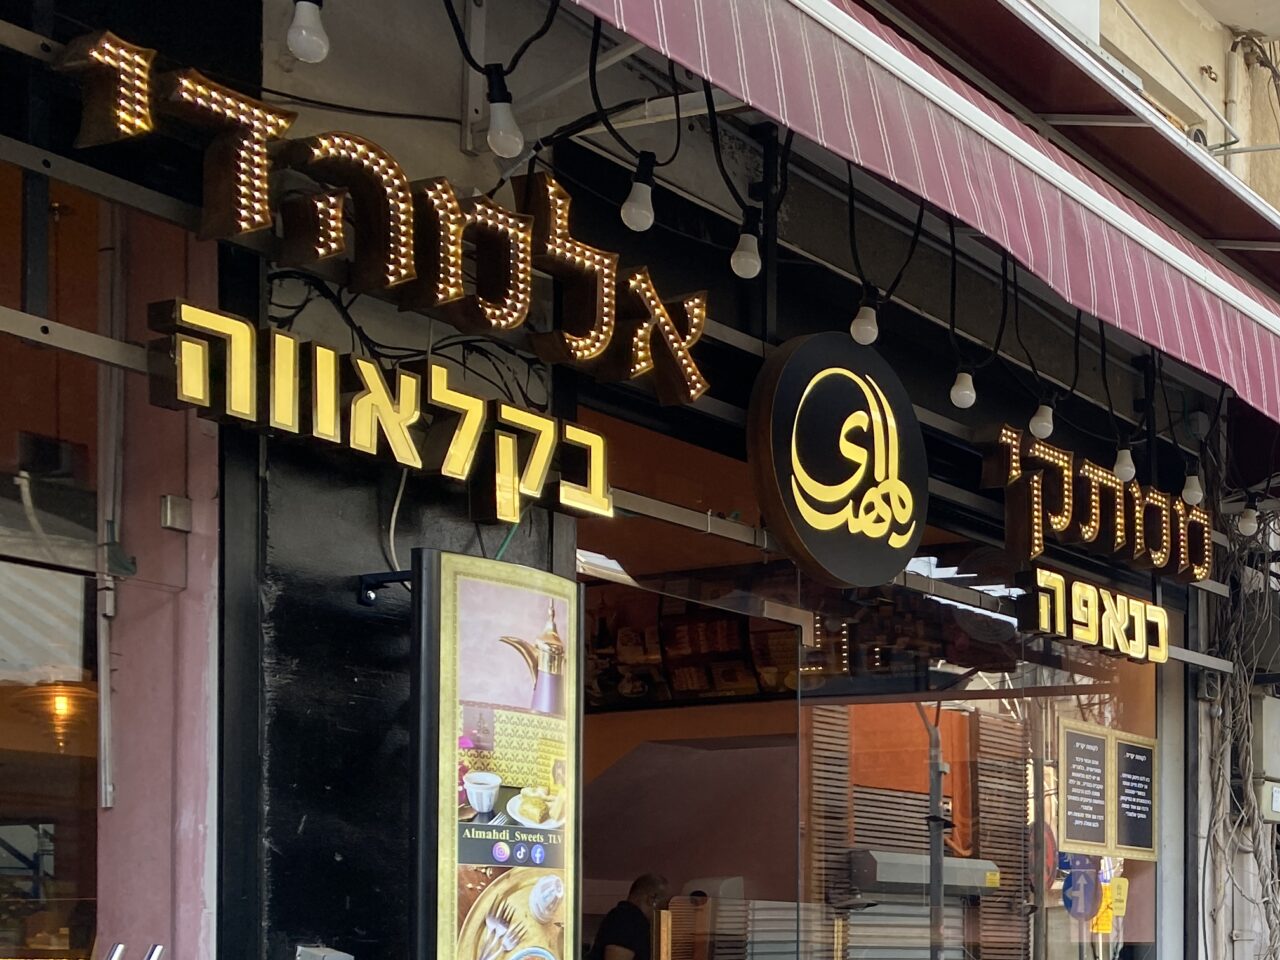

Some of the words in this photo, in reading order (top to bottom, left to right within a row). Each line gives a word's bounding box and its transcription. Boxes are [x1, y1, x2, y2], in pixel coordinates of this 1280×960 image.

[86, 29, 711, 404] אלמהדי
[174, 298, 615, 525] בקלאווה
[998, 423, 1213, 582] ממתקי
[1036, 567, 1169, 664] כנאפה
